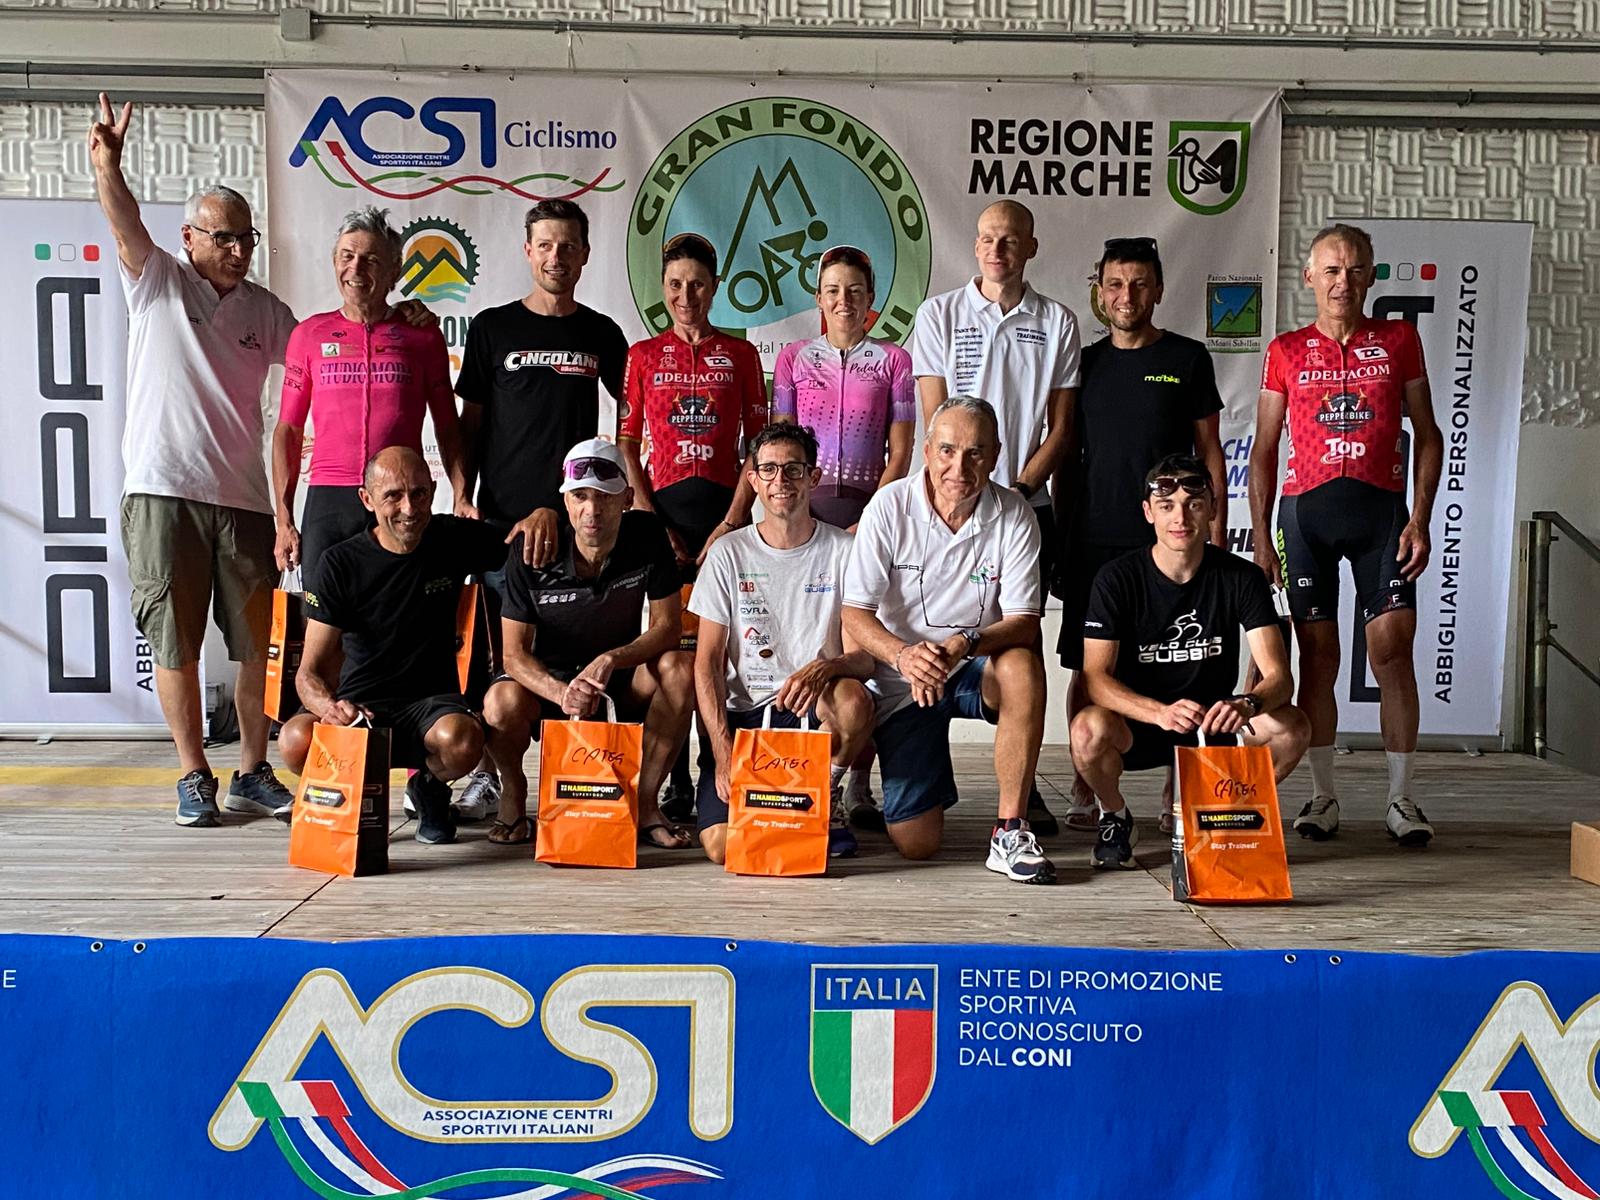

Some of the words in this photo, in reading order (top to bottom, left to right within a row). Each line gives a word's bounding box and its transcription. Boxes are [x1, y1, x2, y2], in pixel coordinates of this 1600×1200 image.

[505, 121, 617, 149] Ciclismo
[971, 119, 1153, 156] REGIONE
[636, 107, 753, 236] GRAN
[772, 103, 923, 241] FONDO
[968, 160, 1151, 197] MARCHE
[664, 372, 734, 383] DELTACOM
[1310, 364, 1390, 382] DELTACOM
[1448, 265, 1479, 492] PERSONALIZZATO
[671, 415, 716, 424] PEPPERBIKE
[1320, 411, 1369, 422] PEPPERBIKE
[677, 440, 713, 461] Top
[1325, 437, 1366, 460] Top
[1434, 503, 1464, 704] ABBIGLIAMENTO
[1138, 645, 1222, 663] GUBBIO
[1139, 641, 1180, 652] VELO
[826, 978, 926, 1001] ITALIA
[960, 969, 1021, 988] ENTE
[1030, 970, 1052, 989] DI
[1061, 971, 1223, 991] PROMOZIONE
[960, 995, 1077, 1015] SPORTIVA
[960, 1021, 1143, 1042] RICONOSCIUTO
[208, 964, 736, 1151] ACSI
[960, 1048, 1007, 1066] DAL
[1011, 1048, 1072, 1067] CONI
[423, 1109, 547, 1121] ASSOCIAZIONE
[553, 1109, 613, 1120] CENTRI
[441, 1124, 517, 1136] SPORTIVI
[522, 1124, 594, 1136] ITALIANI
